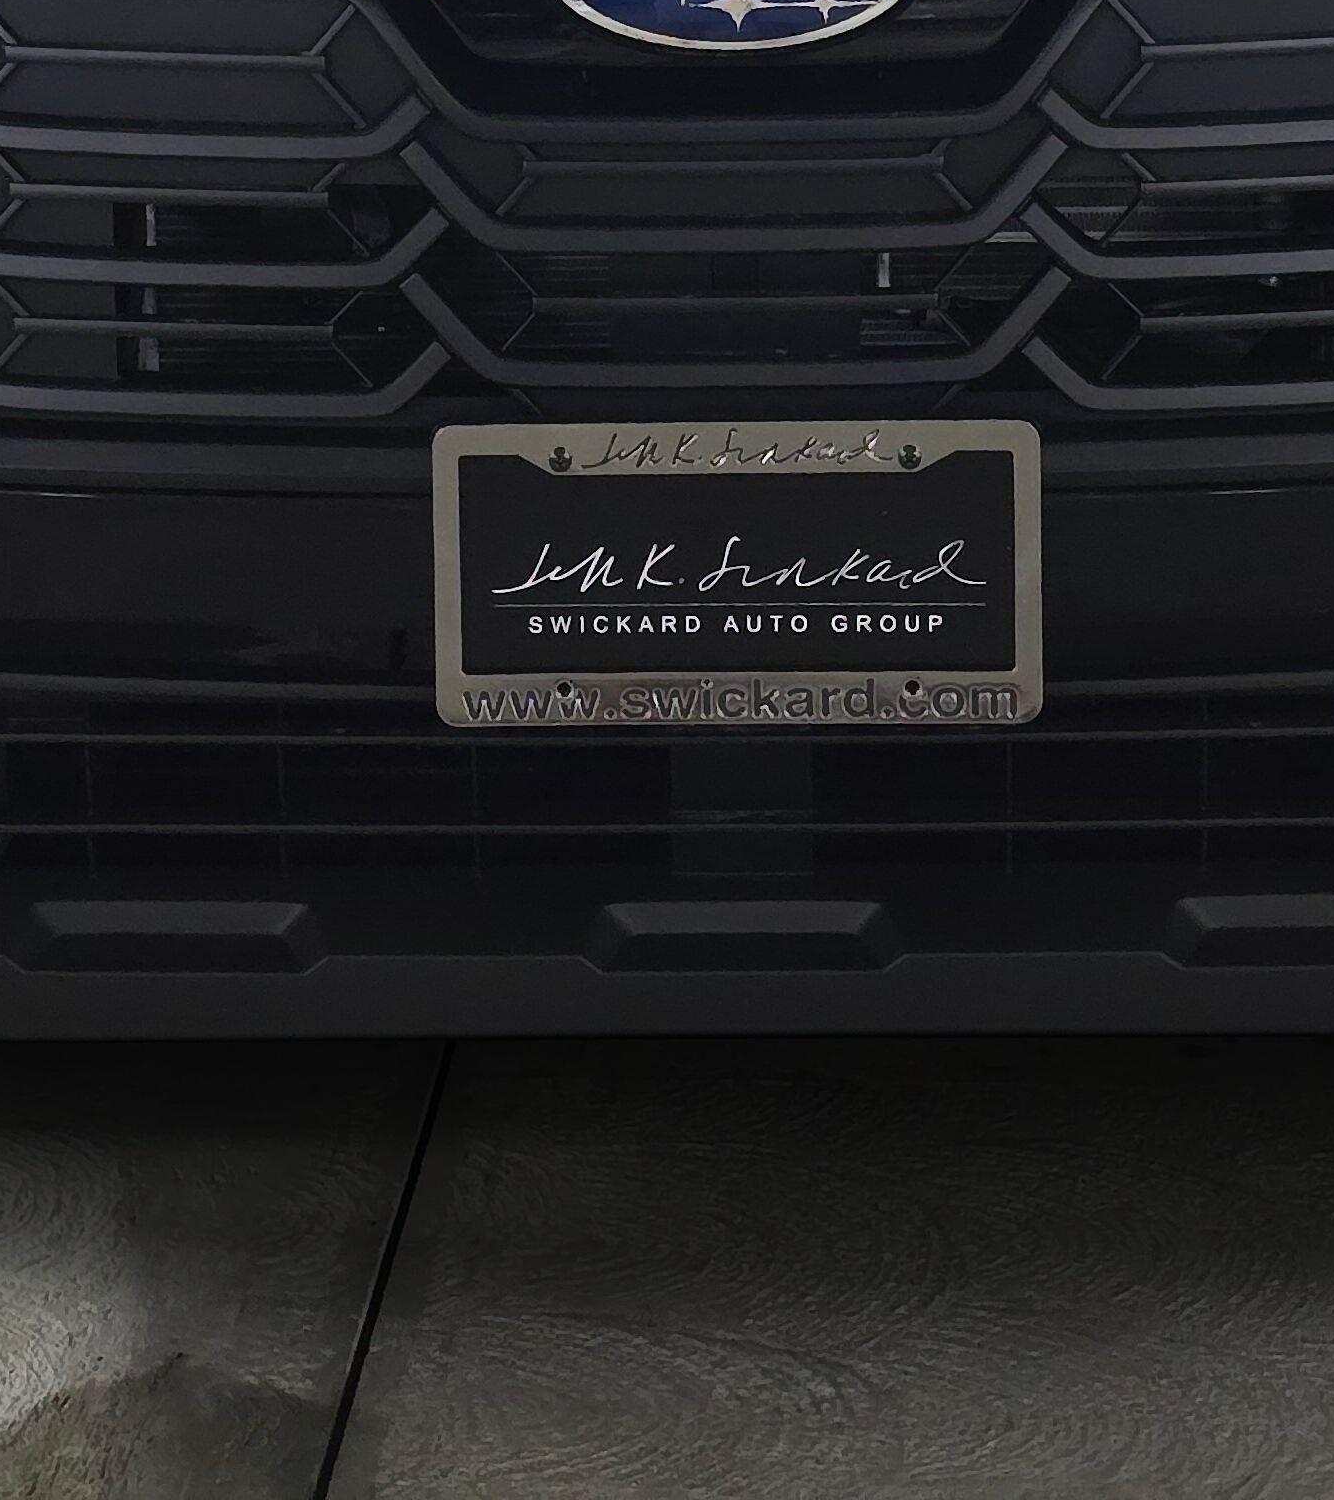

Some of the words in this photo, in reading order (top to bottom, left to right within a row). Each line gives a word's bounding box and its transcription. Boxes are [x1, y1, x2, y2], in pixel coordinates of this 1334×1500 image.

[527, 614, 703, 635] SWICKARD
[722, 614, 810, 634] AUTO
[830, 613, 946, 634] GROUP
[461, 677, 1021, 724] www.swickard.com
